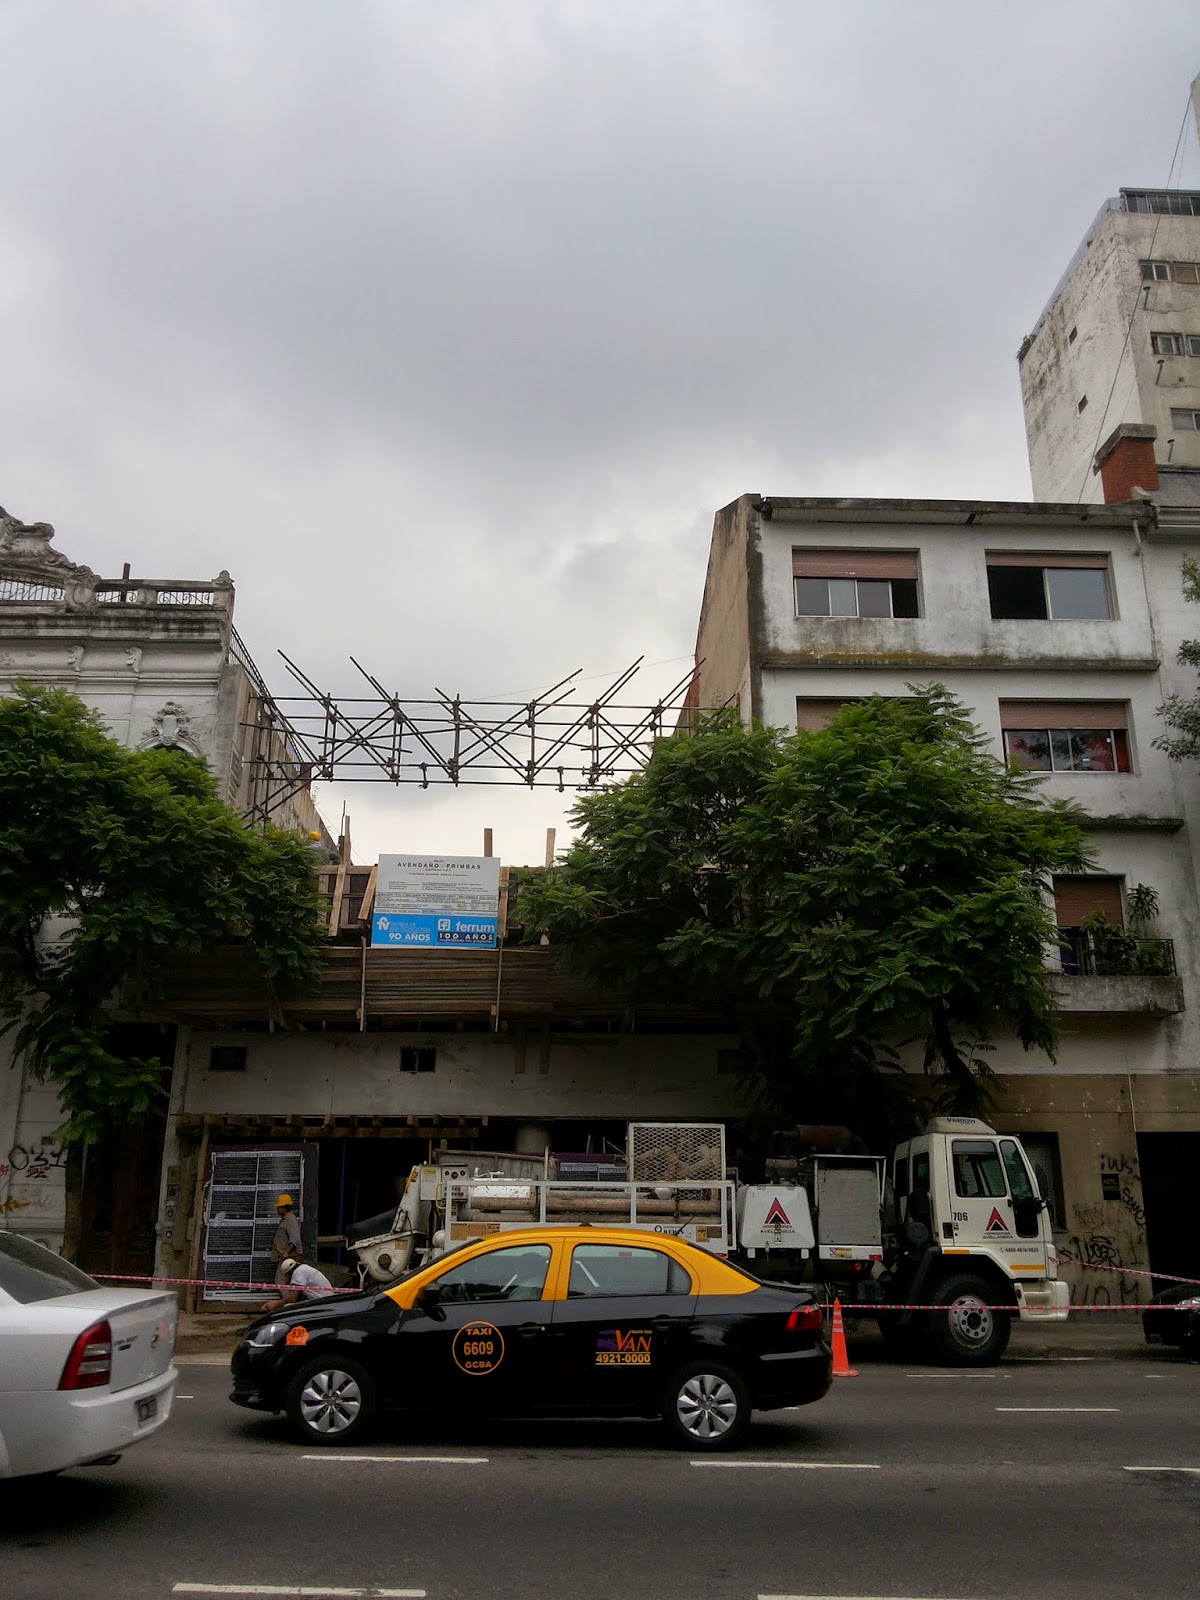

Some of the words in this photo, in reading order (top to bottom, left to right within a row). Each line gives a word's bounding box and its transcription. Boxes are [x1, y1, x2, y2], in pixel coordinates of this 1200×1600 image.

[456, 921, 495, 933] ferrum
[465, 932, 493, 940] AÑOS
[953, 1211, 968, 1221] 706
[465, 1328, 493, 1336] TAXI
[615, 1329, 652, 1351] VAN
[463, 1341, 494, 1356] 6609
[595, 1353, 651, 1363] 4921-0000
[465, 1361, 492, 1369] GCBA
